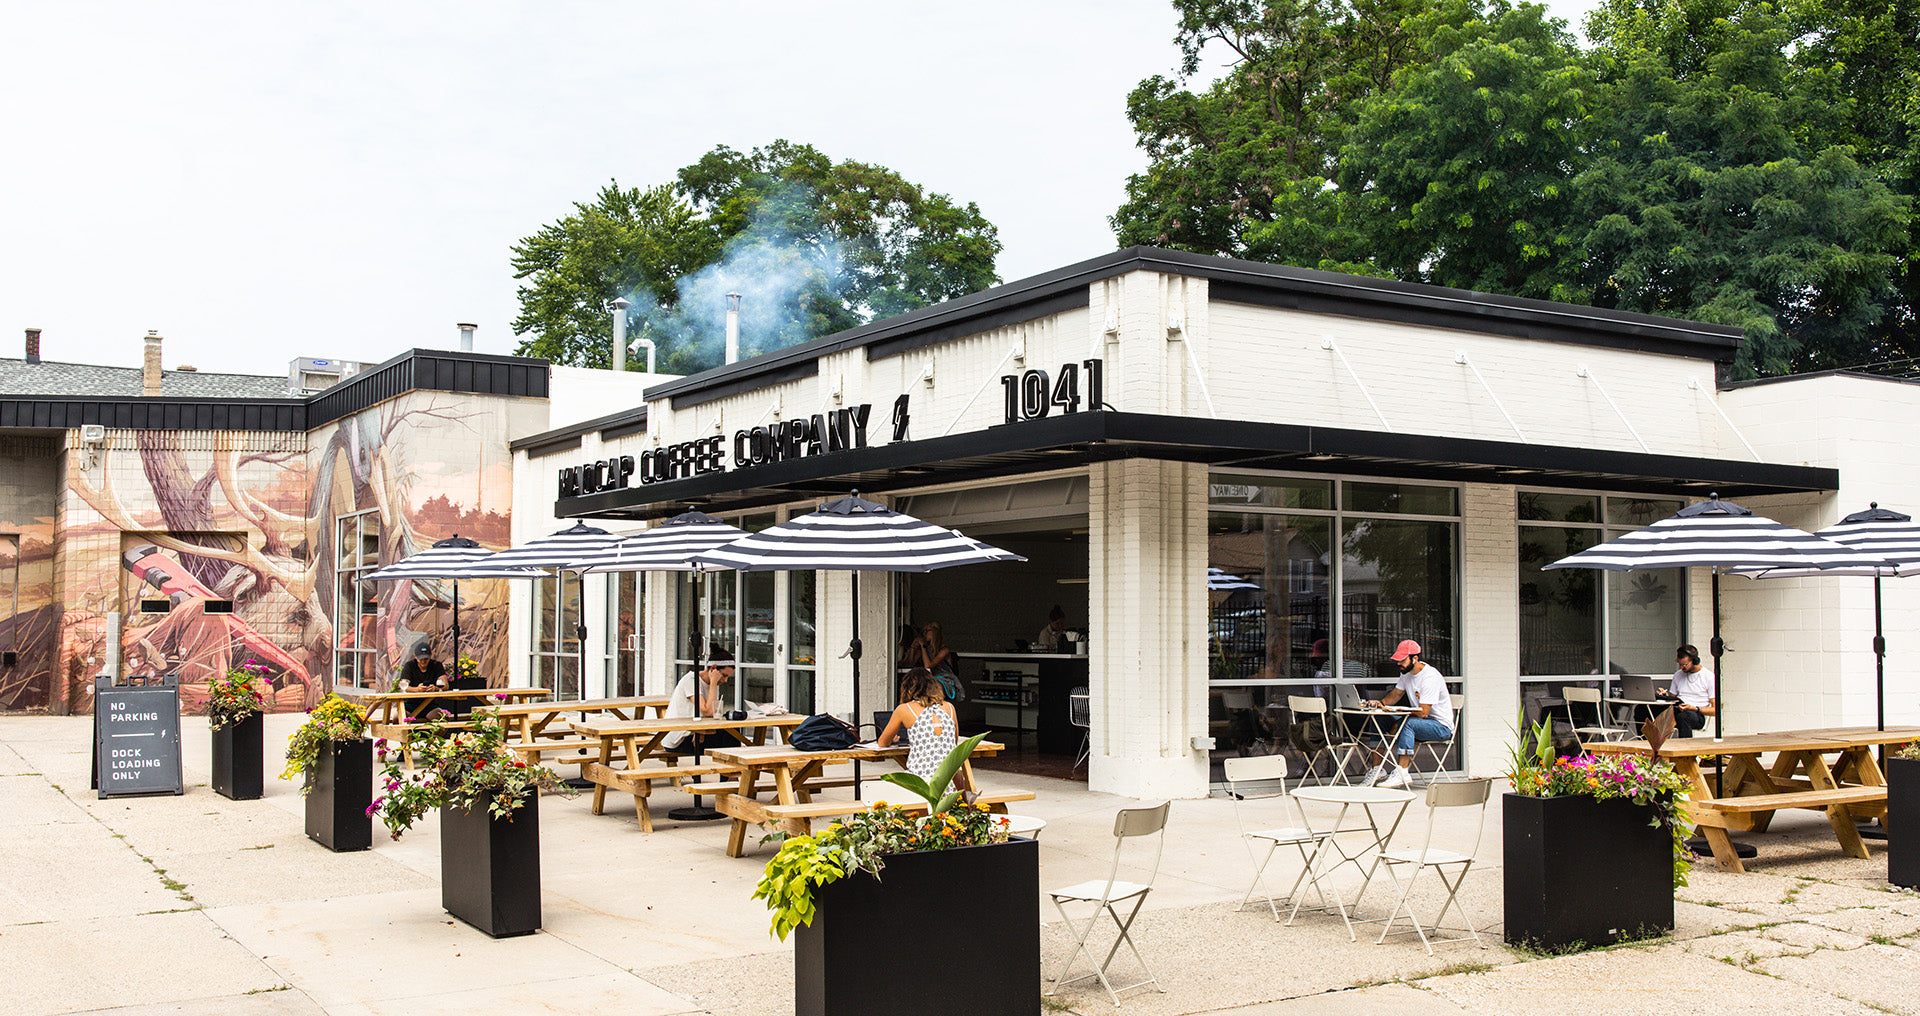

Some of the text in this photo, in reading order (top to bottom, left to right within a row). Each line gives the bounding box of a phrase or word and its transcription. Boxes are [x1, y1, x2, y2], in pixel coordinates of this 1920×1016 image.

[1001, 358, 1102, 424] 1041
[558, 404, 872, 498] MADCAP COFFEE COMPANY
[110, 702, 126, 711] NO
[110, 712, 158, 722] PARKING
[111, 749, 142, 758] DOCK
[111, 759, 161, 769] LOADING
[112, 771, 141, 780] ONLY
